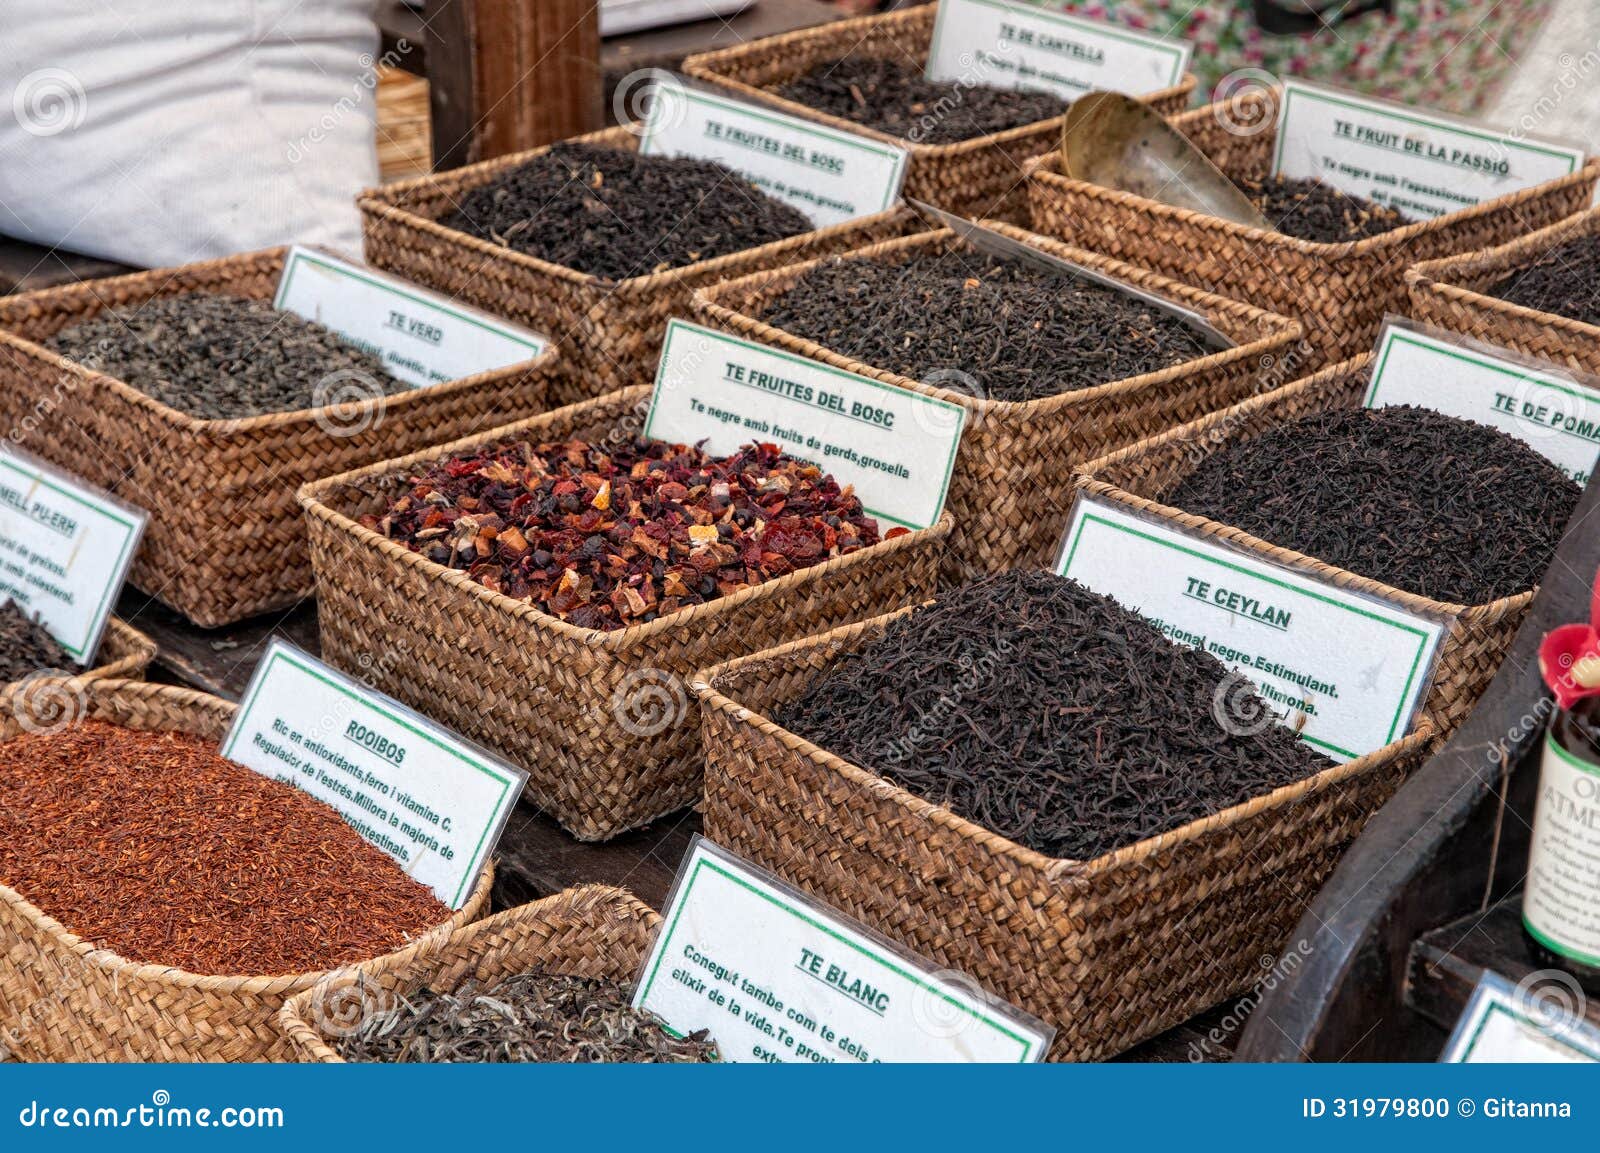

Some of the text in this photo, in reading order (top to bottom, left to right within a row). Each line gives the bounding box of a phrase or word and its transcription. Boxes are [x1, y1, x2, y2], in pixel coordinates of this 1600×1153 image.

[706, 120, 845, 173] TE FRUITES DEL BOSC
[1335, 119, 1352, 136] TE
[1357, 125, 1400, 149] FRUIT
[1404, 136, 1423, 153] DE
[1429, 144, 1447, 160] LA
[388, 310, 444, 342] TE VERD
[725, 362, 895, 428] TE FRUITES DEL BOSC
[1495, 392, 1518, 412] TE
[1522, 402, 1548, 422] DE
[690, 398, 705, 413] Te
[708, 406, 741, 425] negre
[744, 416, 769, 433] amb
[772, 423, 803, 446] fruits
[806, 435, 821, 450] de
[1187, 577, 1292, 629] TE CEYLAN
[346, 719, 407, 764] ROOIBOS
[252, 731, 301, 769] Regulador
[301, 759, 316, 778] de
[388, 811, 399, 829] la
[399, 821, 439, 853] majoria
[440, 842, 454, 861] de
[272, 717, 288, 737] Ric
[289, 730, 303, 744] en
[396, 788, 440, 825] vitamina
[440, 815, 453, 833] C.
[671, 967, 709, 996] elixir
[708, 987, 726, 1007] de
[727, 997, 741, 1017] la
[683, 944, 740, 986] Conegut
[740, 977, 785, 1012] tambe
[787, 1006, 818, 1033] com
[819, 1025, 836, 1044] te
[838, 1035, 870, 1064] dels
[799, 947, 891, 1013] TE BLANC
